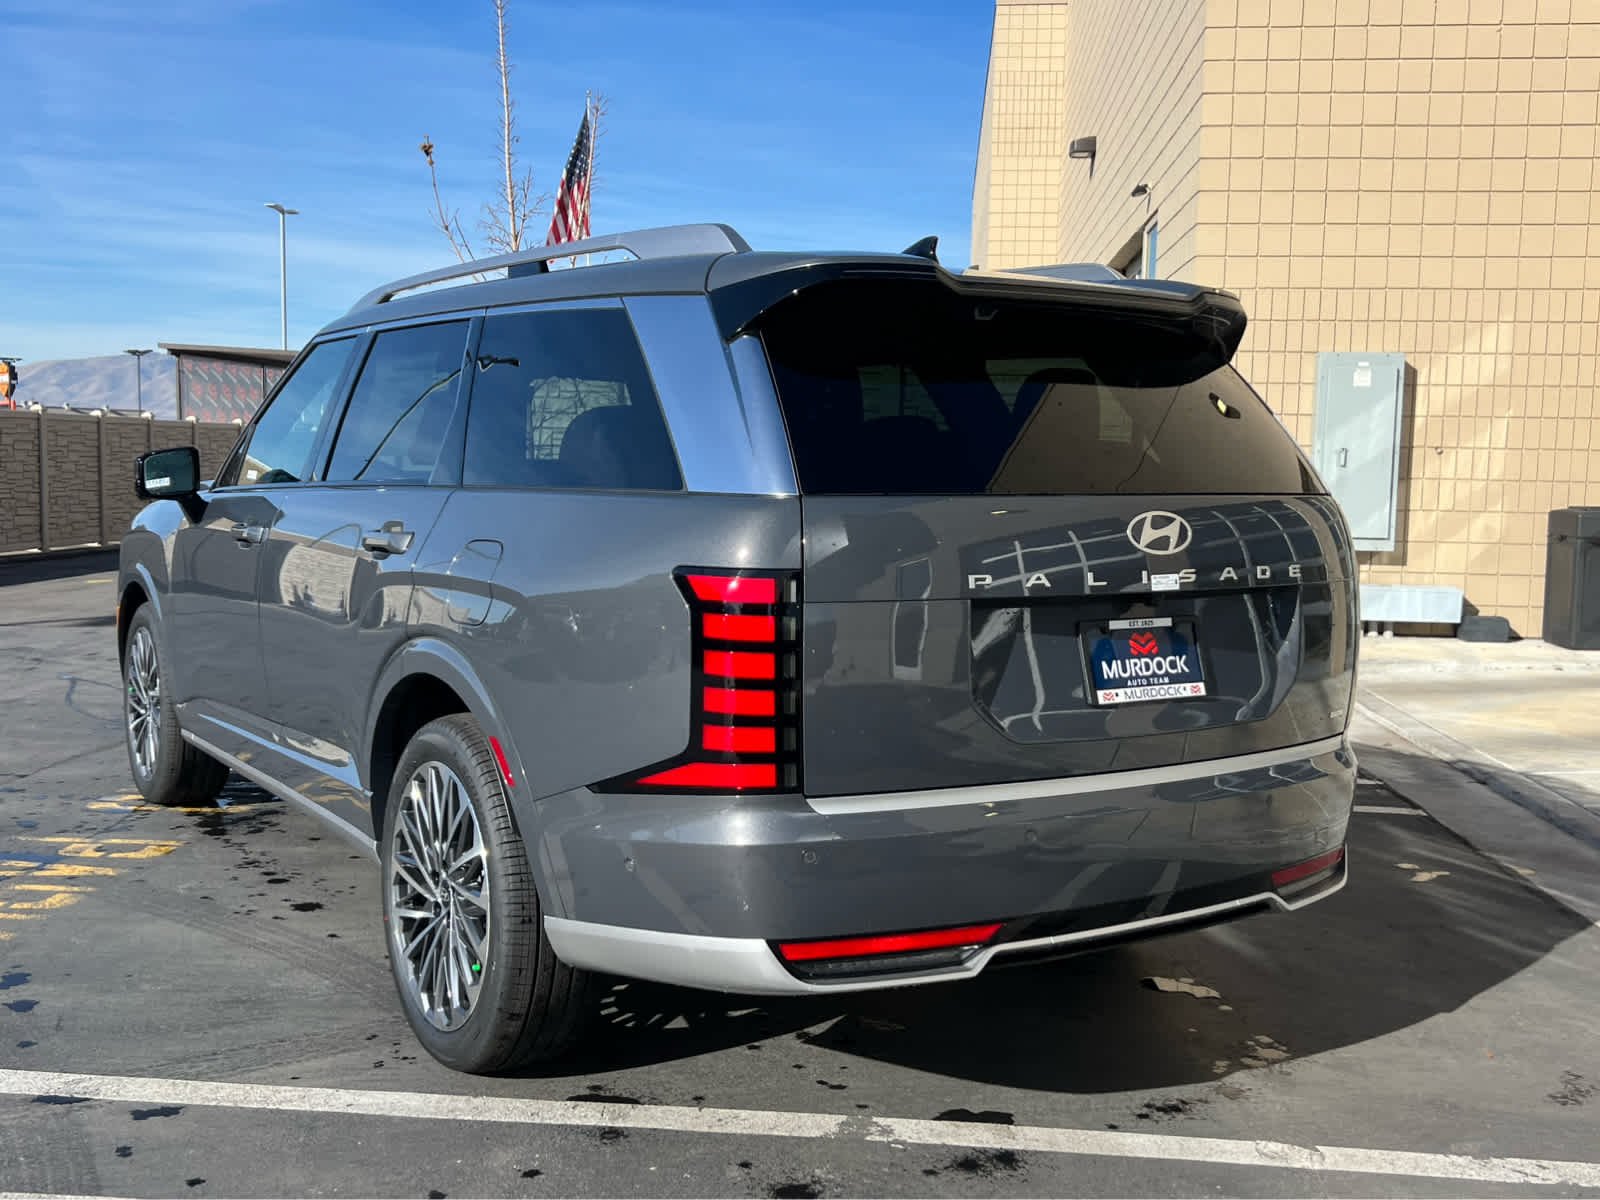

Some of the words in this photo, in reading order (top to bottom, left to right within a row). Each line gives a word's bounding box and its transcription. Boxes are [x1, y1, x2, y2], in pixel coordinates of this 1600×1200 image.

[968, 563, 1302, 589] PALISADE
[1101, 655, 1190, 679] MURDOCK
[1127, 678, 1148, 686] AUTO
[1124, 686, 1182, 700] MURDOCK
